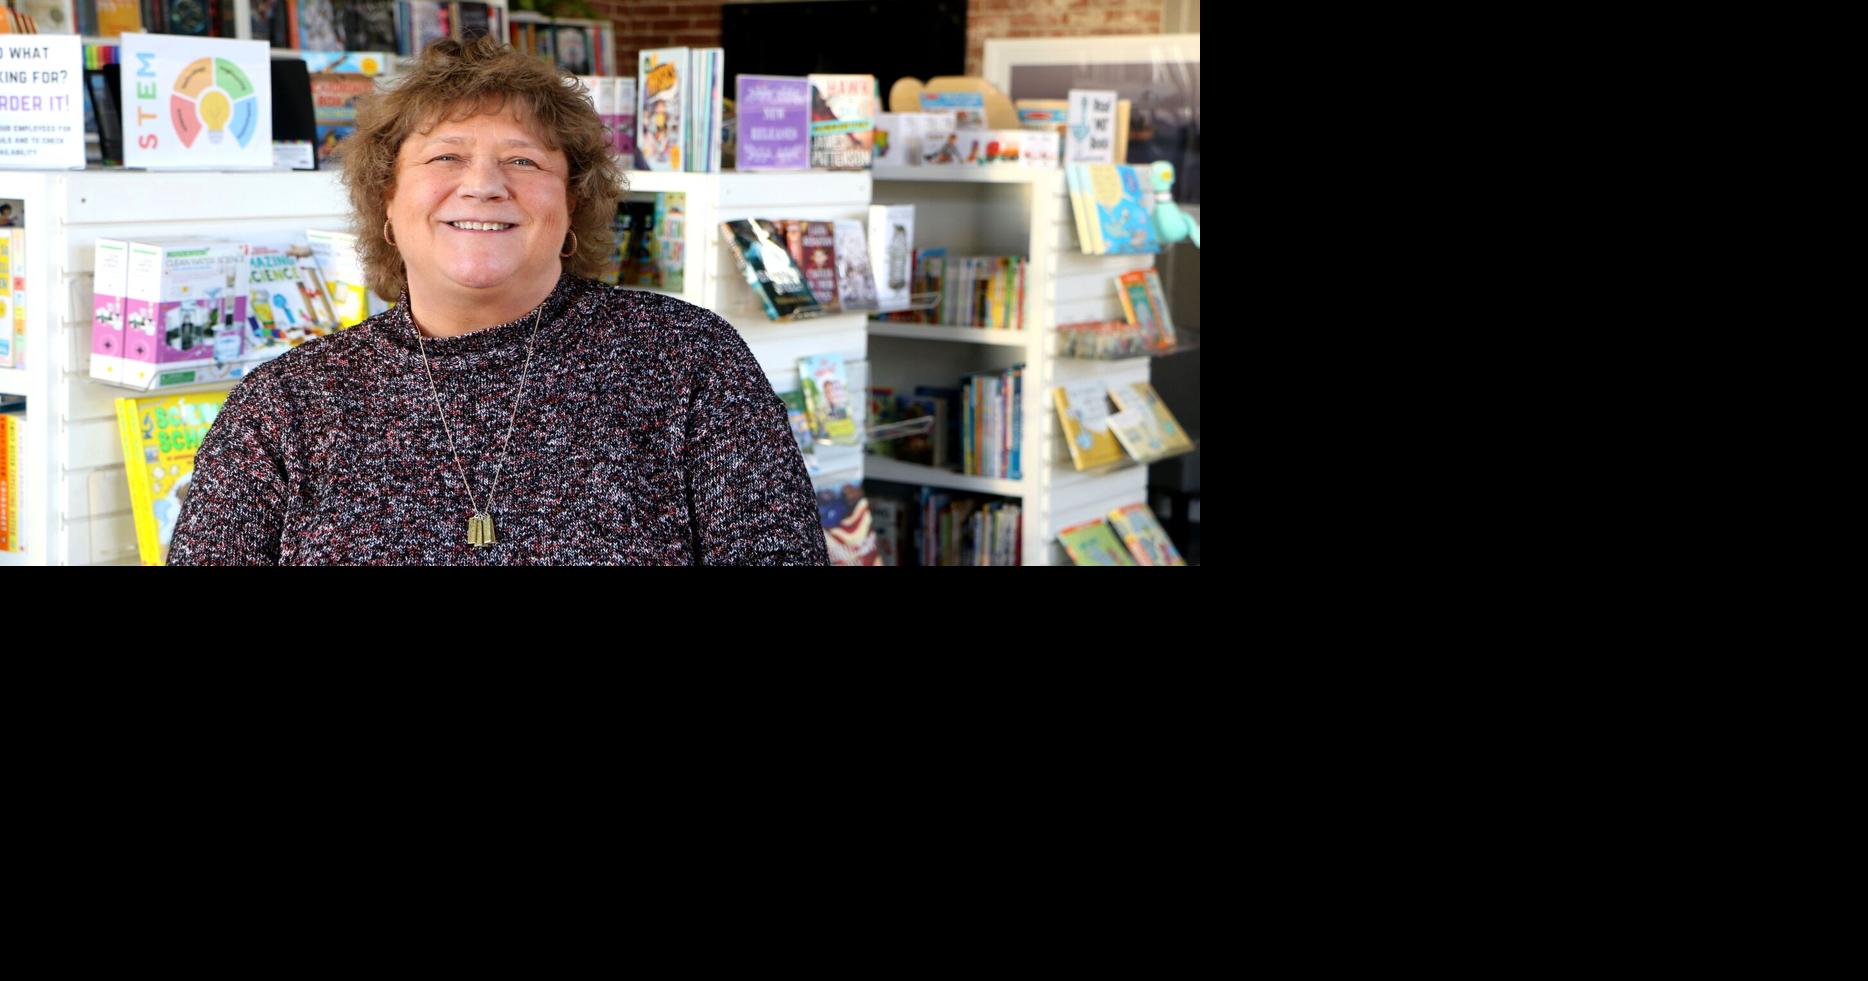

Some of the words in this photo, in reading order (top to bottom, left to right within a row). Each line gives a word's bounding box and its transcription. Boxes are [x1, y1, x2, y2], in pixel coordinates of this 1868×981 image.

[9, 47, 49, 59] WHAT
[32, 70, 68, 84] FOR?
[49, 94, 70, 112] IT!
[136, 52, 158, 150] STEM
